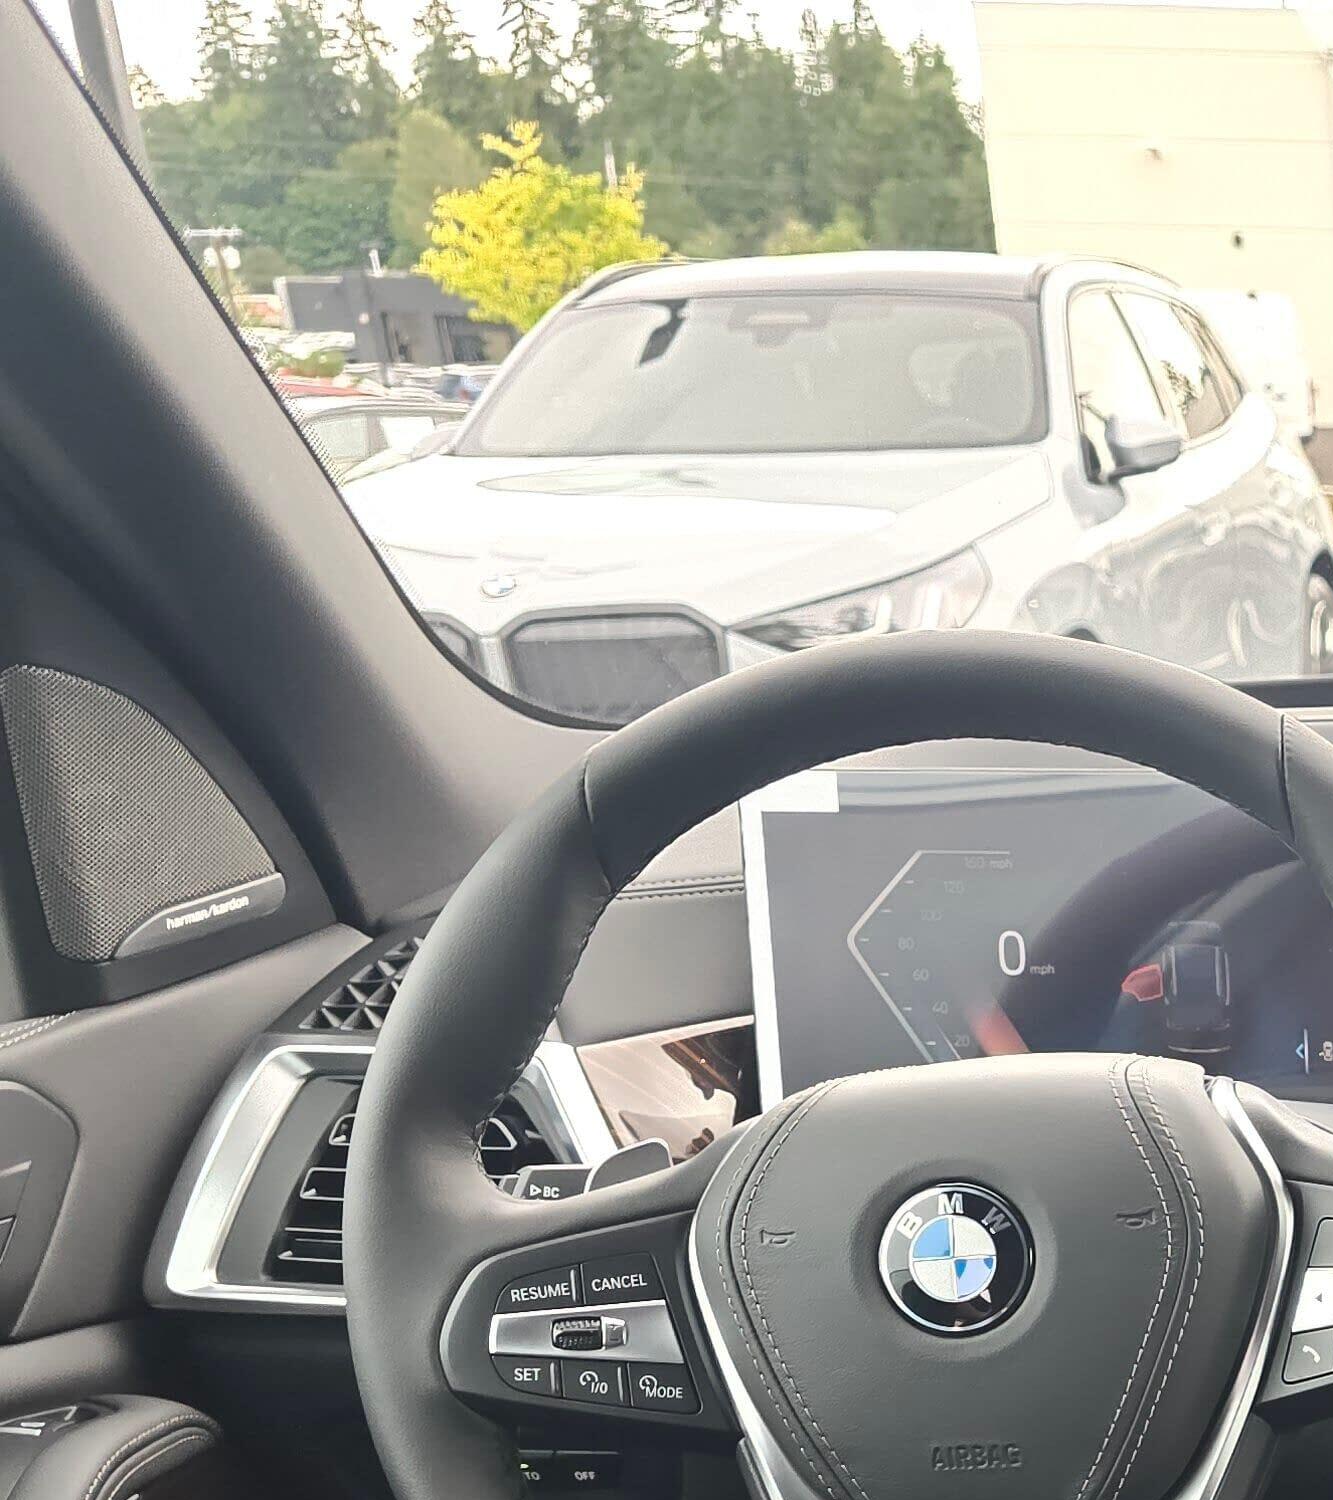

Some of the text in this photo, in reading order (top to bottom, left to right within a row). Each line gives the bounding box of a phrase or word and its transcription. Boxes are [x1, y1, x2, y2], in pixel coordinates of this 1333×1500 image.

[998, 930, 1055, 977] 0 mph
[912, 968, 929, 981] 60
[932, 1001, 949, 1014] 40
[954, 1035, 970, 1047] 20
[896, 1192, 1012, 1240] BMW
[591, 1273, 648, 1293] CANCEL
[510, 1282, 571, 1303] RESUME
[513, 1367, 541, 1382] SET
[645, 1386, 683, 1399] MODE
[931, 1442, 1022, 1471] AIRBAG
[574, 1471, 595, 1481] OFF
